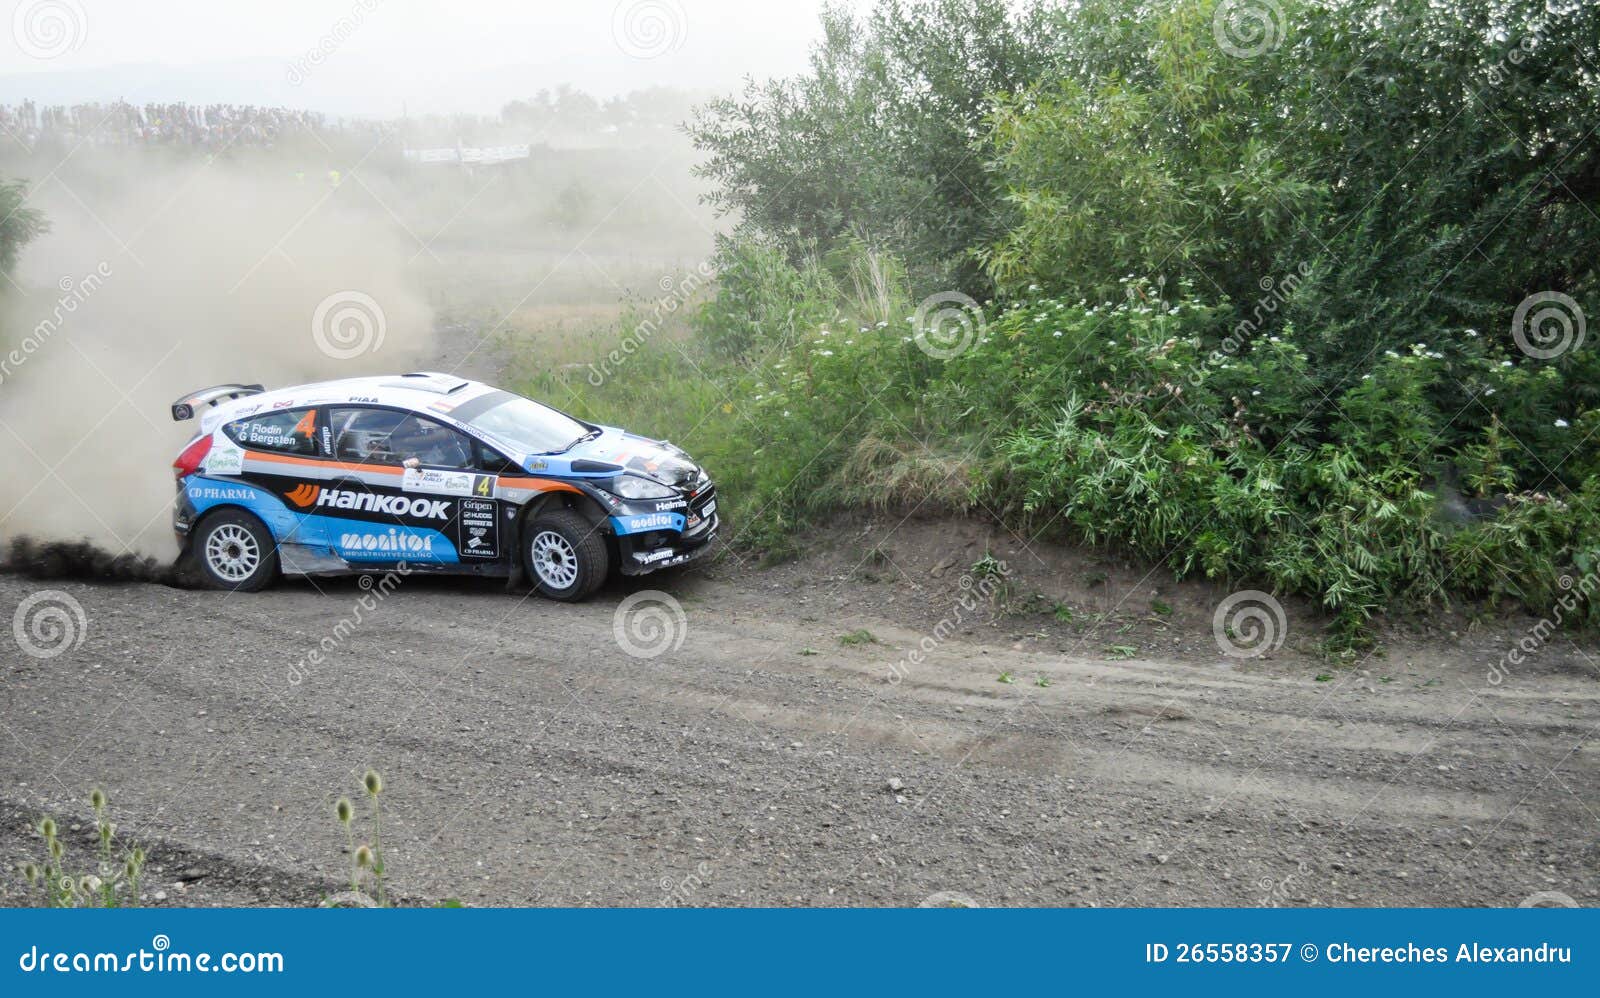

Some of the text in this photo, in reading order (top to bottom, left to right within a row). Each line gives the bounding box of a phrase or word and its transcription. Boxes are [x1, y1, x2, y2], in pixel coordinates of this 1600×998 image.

[241, 422, 282, 434] P Flodin
[295, 409, 317, 439] 4
[239, 431, 296, 446] G Bergsten
[477, 476, 490, 497] 4
[188, 487, 257, 501] CD PHARMA
[463, 500, 493, 512] Gripen
[655, 499, 687, 512] Helmia
[340, 527, 435, 551] monitor
